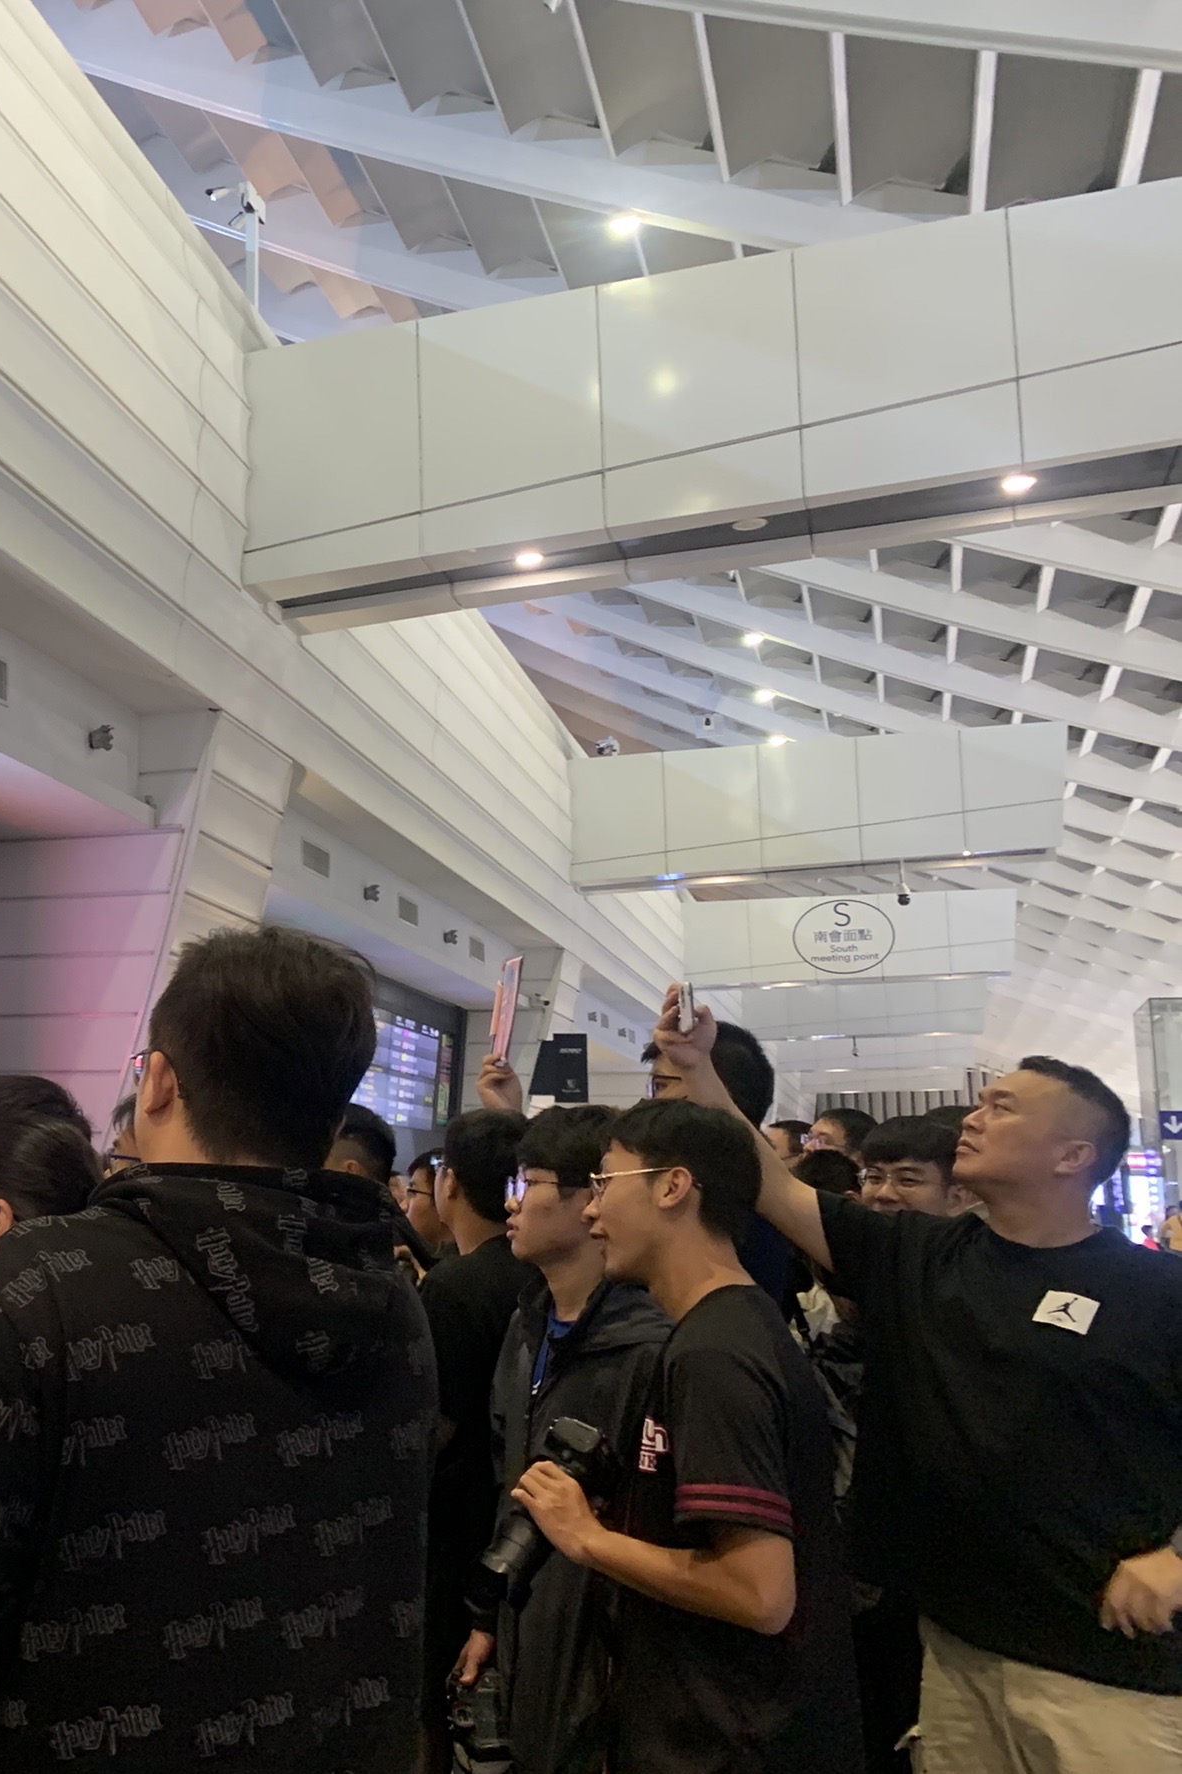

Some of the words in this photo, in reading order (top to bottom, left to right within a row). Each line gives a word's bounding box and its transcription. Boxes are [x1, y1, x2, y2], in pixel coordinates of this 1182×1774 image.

[833, 902, 851, 927] S
[813, 928, 873, 943] 南會面點
[830, 944, 858, 953] South
[811, 955, 851, 963] meeting
[853, 952, 879, 963] point
[129, 1255, 180, 1290] Harry
